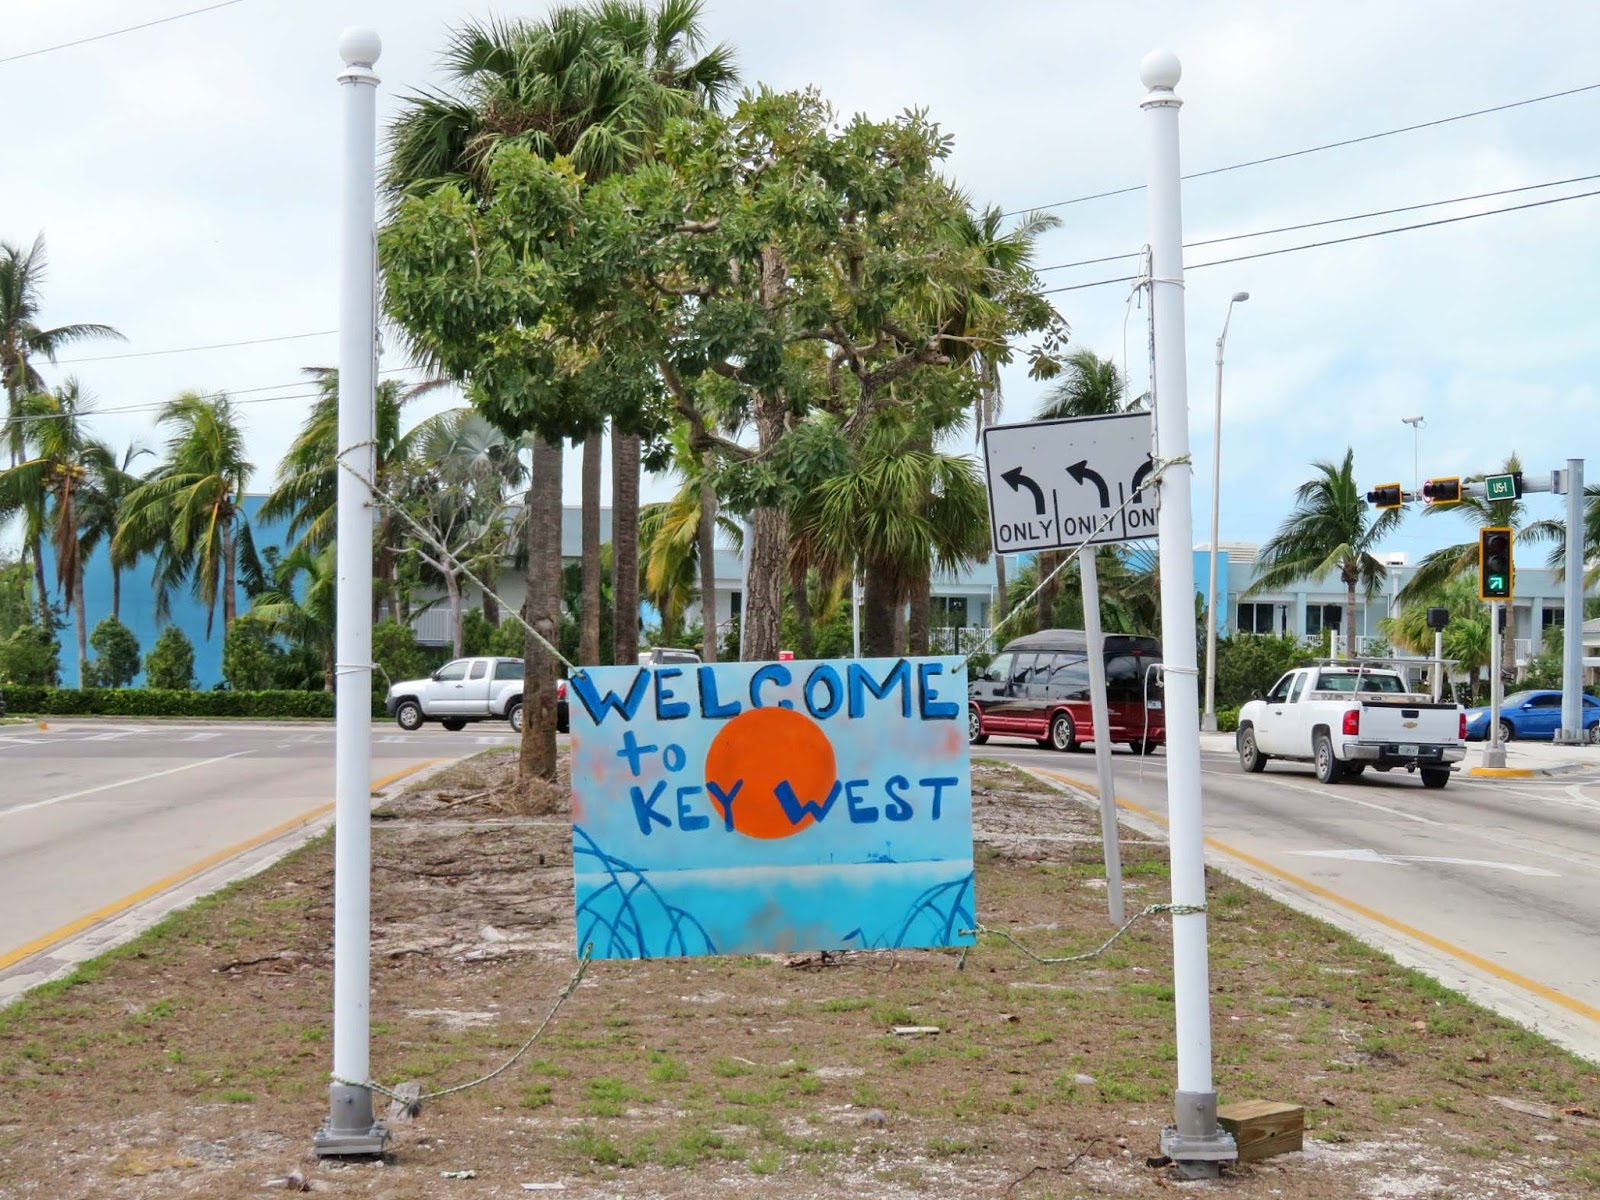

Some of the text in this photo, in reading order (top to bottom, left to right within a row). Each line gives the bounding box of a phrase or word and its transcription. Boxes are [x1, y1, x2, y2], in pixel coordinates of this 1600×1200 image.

[999, 519, 1053, 543] ONLY
[1064, 513, 1115, 536] ONLY
[1128, 508, 1159, 528] ON
[570, 659, 960, 726] WELCOME
[616, 730, 687, 776] to
[629, 775, 959, 836] KEY WEST
